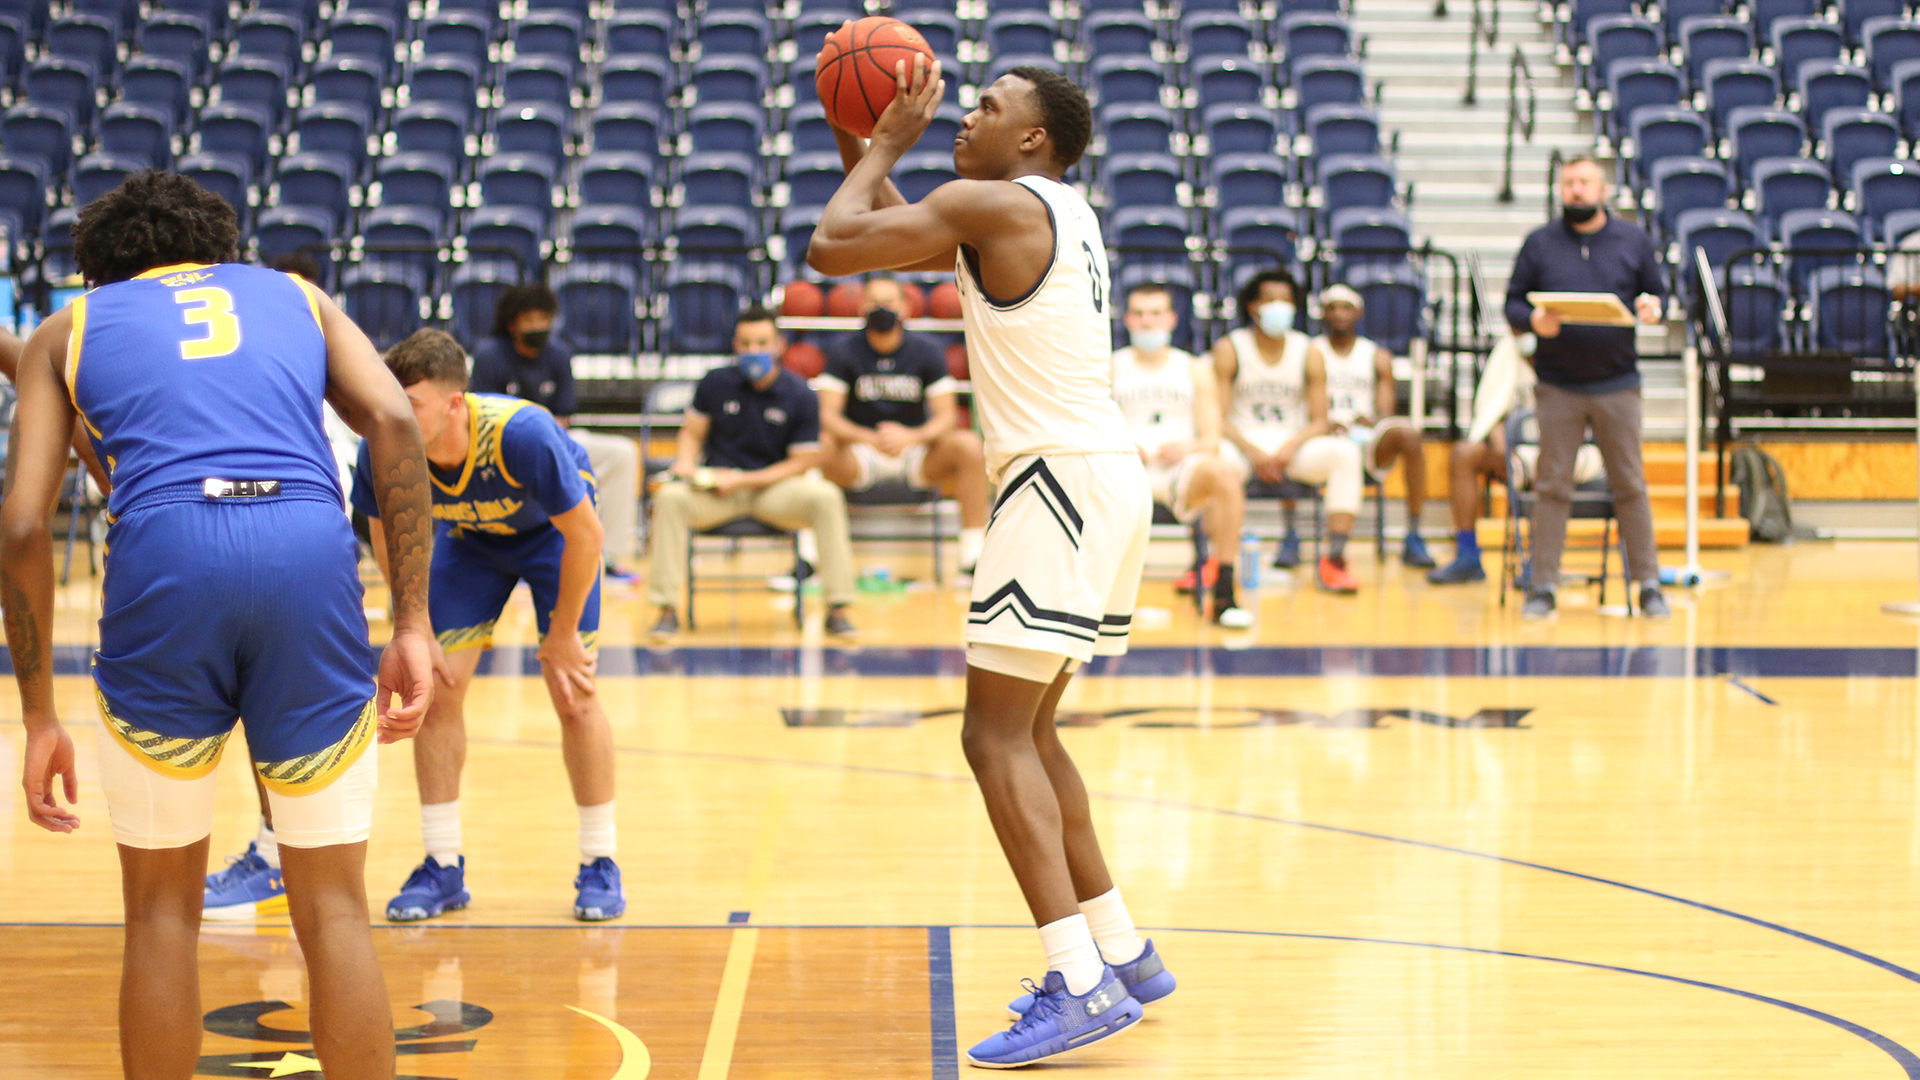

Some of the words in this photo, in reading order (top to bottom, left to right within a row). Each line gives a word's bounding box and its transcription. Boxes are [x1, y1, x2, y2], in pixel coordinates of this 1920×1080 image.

[174, 286, 241, 360] 3
[432, 501, 478, 522] ARS
[473, 496, 524, 522] HILL
